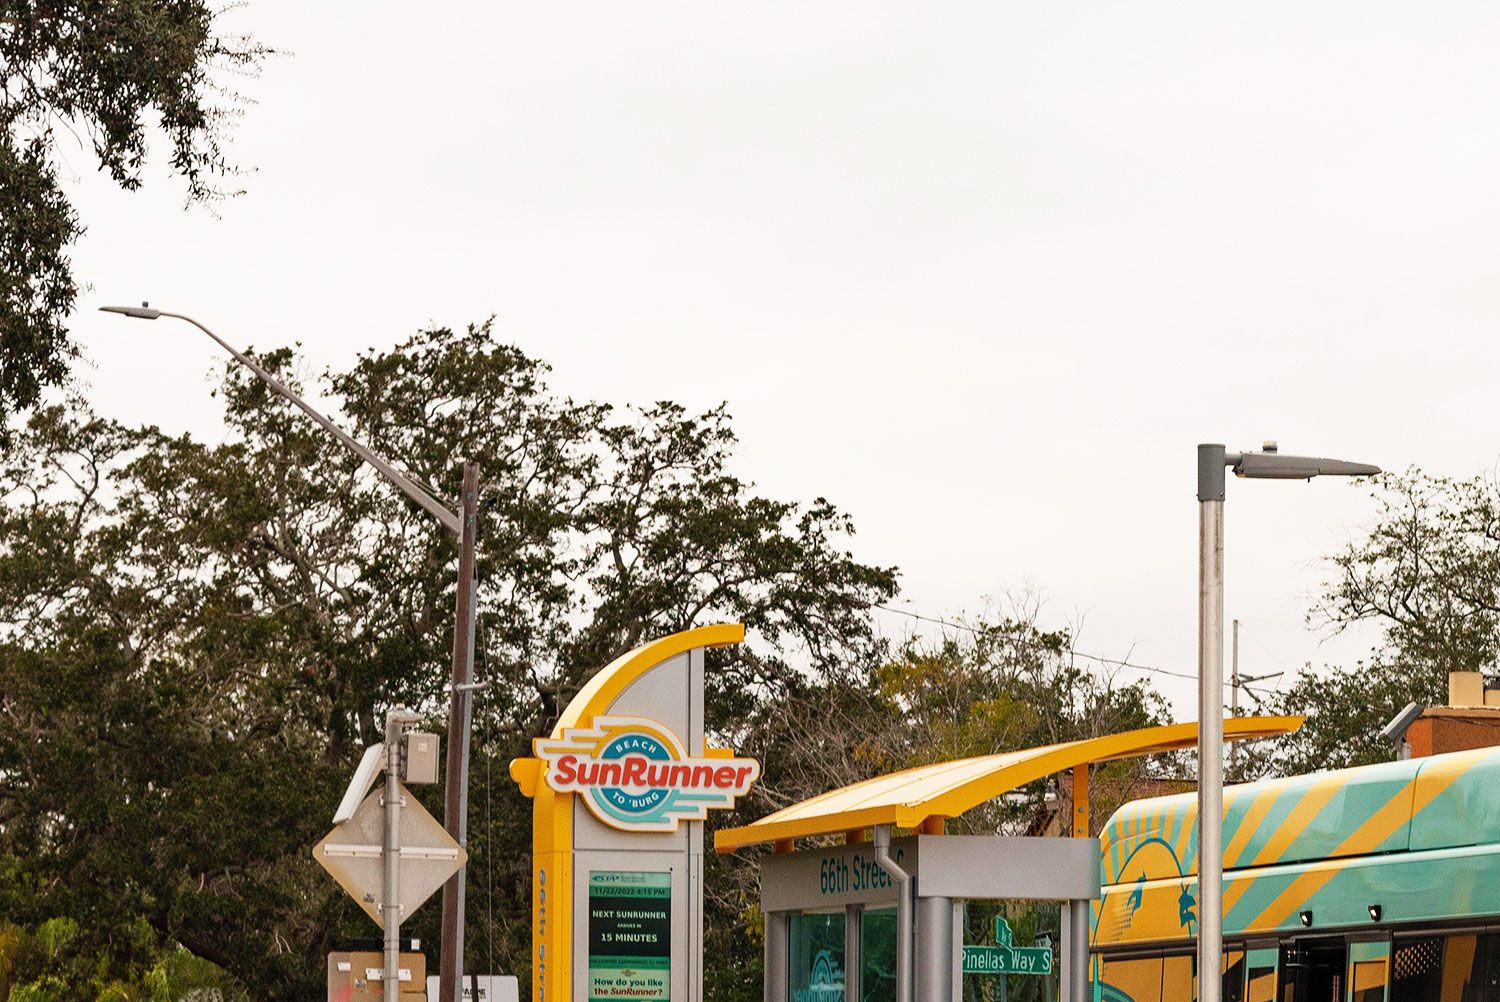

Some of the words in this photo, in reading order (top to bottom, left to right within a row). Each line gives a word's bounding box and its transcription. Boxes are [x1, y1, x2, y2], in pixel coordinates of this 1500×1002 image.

[616, 738, 657, 754] BEACH
[555, 755, 752, 788] SunRunner
[612, 791, 625, 804] TO
[629, 791, 660, 809] 'BURG
[820, 855, 849, 894] 66th
[592, 910, 614, 918] NEXT
[616, 910, 666, 919] SUNRUNNER
[601, 933, 612, 942] 15
[615, 933, 658, 942] MINUTES
[1011, 950, 1036, 972] Way
[1042, 951, 1050, 970] S
[594, 978, 613, 986] How
[629, 980, 645, 988] you
